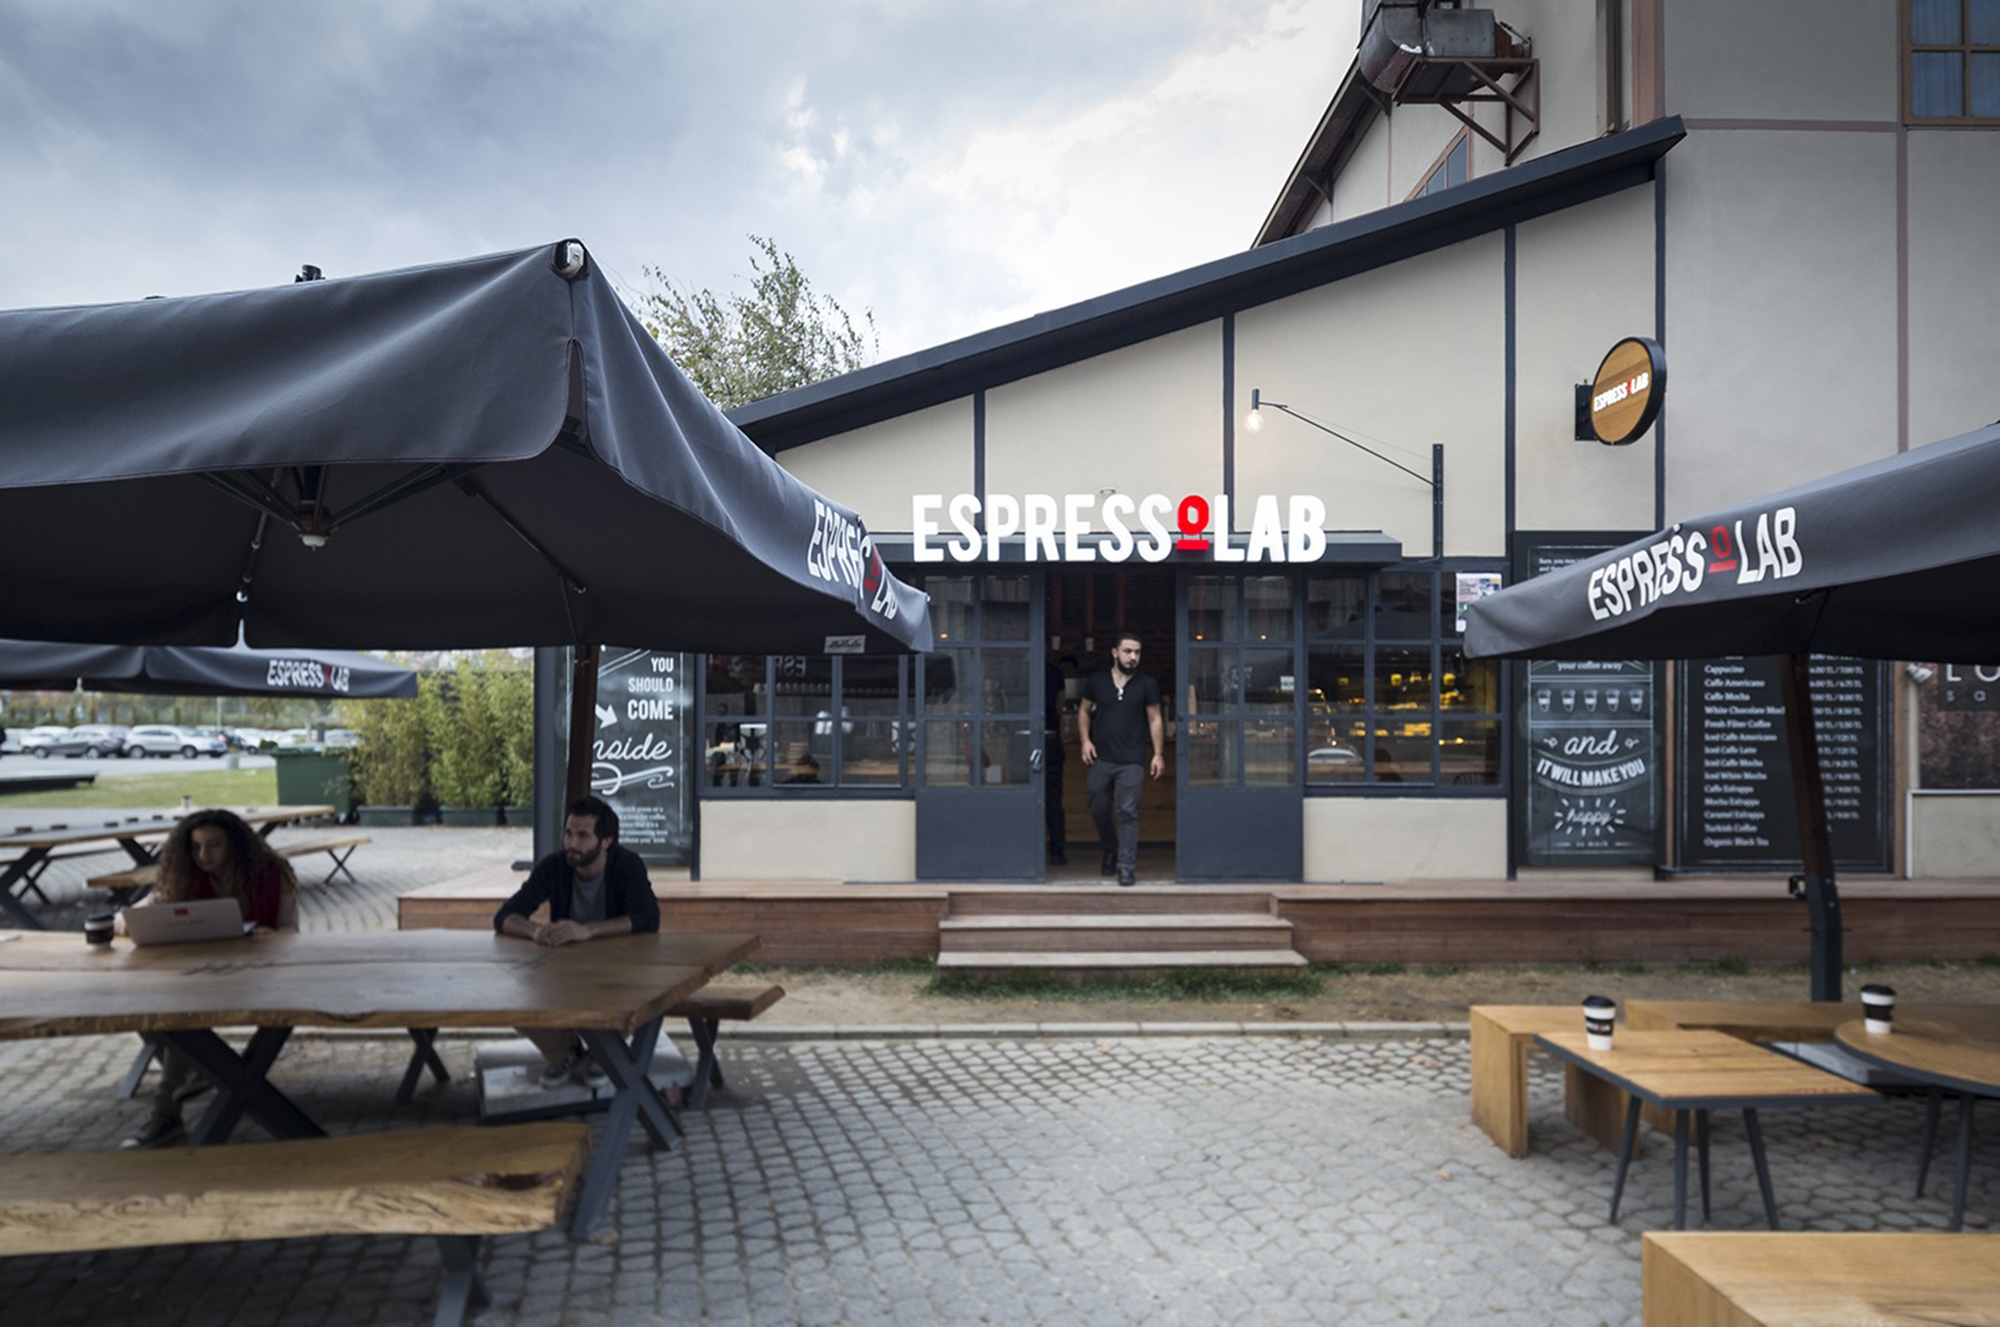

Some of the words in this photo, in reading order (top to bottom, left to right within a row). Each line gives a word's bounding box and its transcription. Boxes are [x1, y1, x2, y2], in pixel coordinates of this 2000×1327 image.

[911, 493, 1328, 563] ESPRESSOLAB
[1587, 506, 1803, 621] ESPRESSOLAB
[650, 657, 674, 673] YOU
[627, 676, 674, 693] SHOULD
[627, 699, 674, 720] COME
[592, 732, 673, 761] nside
[1563, 729, 1620, 755] and
[1536, 758, 1553, 776] IT
[1551, 763, 1581, 786] WILL
[1581, 766, 1622, 787] MAKE
[1617, 757, 1647, 780] YOU
